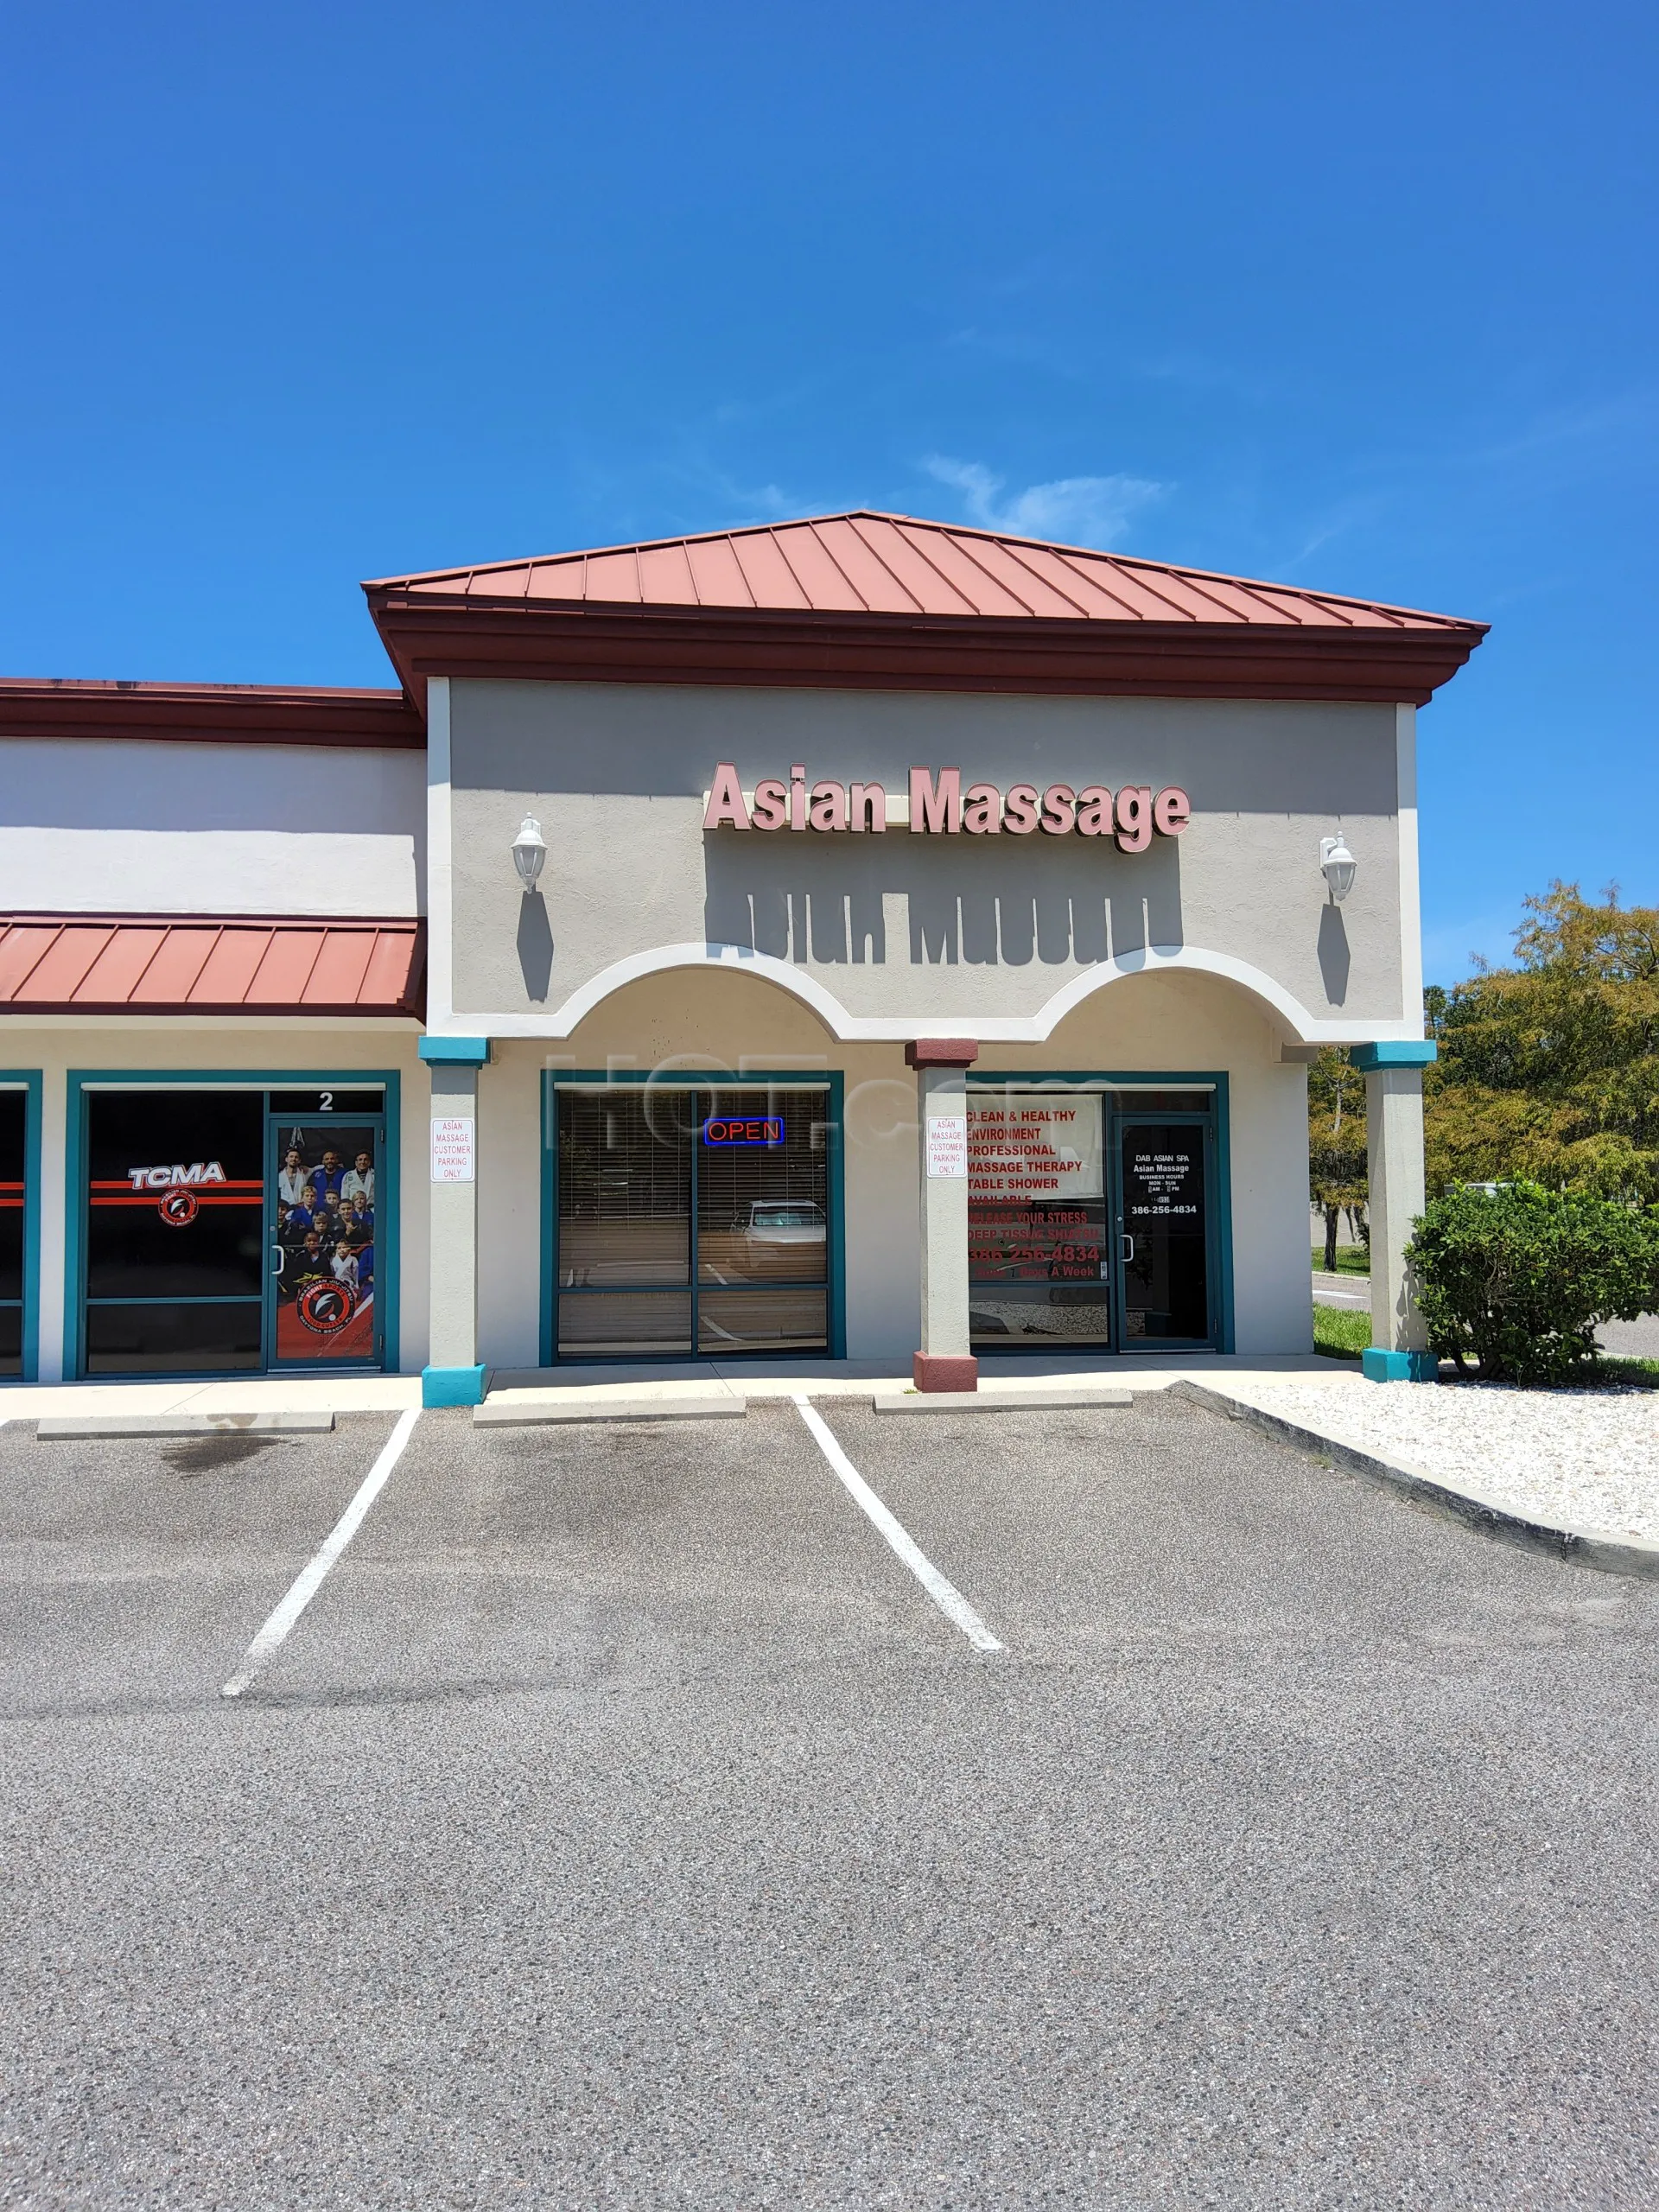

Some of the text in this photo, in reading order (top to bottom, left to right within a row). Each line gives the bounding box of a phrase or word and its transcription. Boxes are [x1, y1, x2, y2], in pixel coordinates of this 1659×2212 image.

[702, 760, 1192, 854] Asian Massage
[318, 1091, 334, 1112] 2
[966, 1110, 1076, 1122] CLEAN & HEALTHY
[937, 1120, 956, 1128] ASIAN
[708, 1121, 780, 1141] OPEN
[931, 1131, 962, 1140] MASSAGE
[967, 1128, 1040, 1141] ENVIRONMENT
[435, 1134, 469, 1142] MASSAGE
[930, 1142, 963, 1151] CUSTOMER
[967, 1145, 1056, 1156] PROFESSIONAL
[437, 1157, 467, 1166] PARKING
[933, 1154, 960, 1162] PARKING
[938, 1165, 955, 1173] ONLY
[967, 1160, 1082, 1173] MASSAGE THERAPY
[1156, 1164, 1189, 1173] Massage
[128, 1161, 226, 1190] TCMA
[443, 1169, 461, 1178] ONLY
[968, 1178, 1059, 1189] TABLE SHOWER
[968, 1195, 1033, 1206] AVAILABLE
[1131, 1205, 1197, 1214] 386-256-4834
[968, 1211, 1088, 1224] RELEASE YOUR STRESS
[968, 1230, 997, 1241] DEEP
[1001, 1230, 1044, 1240] TISSUE
[1051, 1265, 1060, 1277] A
[1063, 1264, 1095, 1277] Week
[306, 1284, 323, 1299] FIGHT
[300, 1315, 322, 1333] DAYTONA
